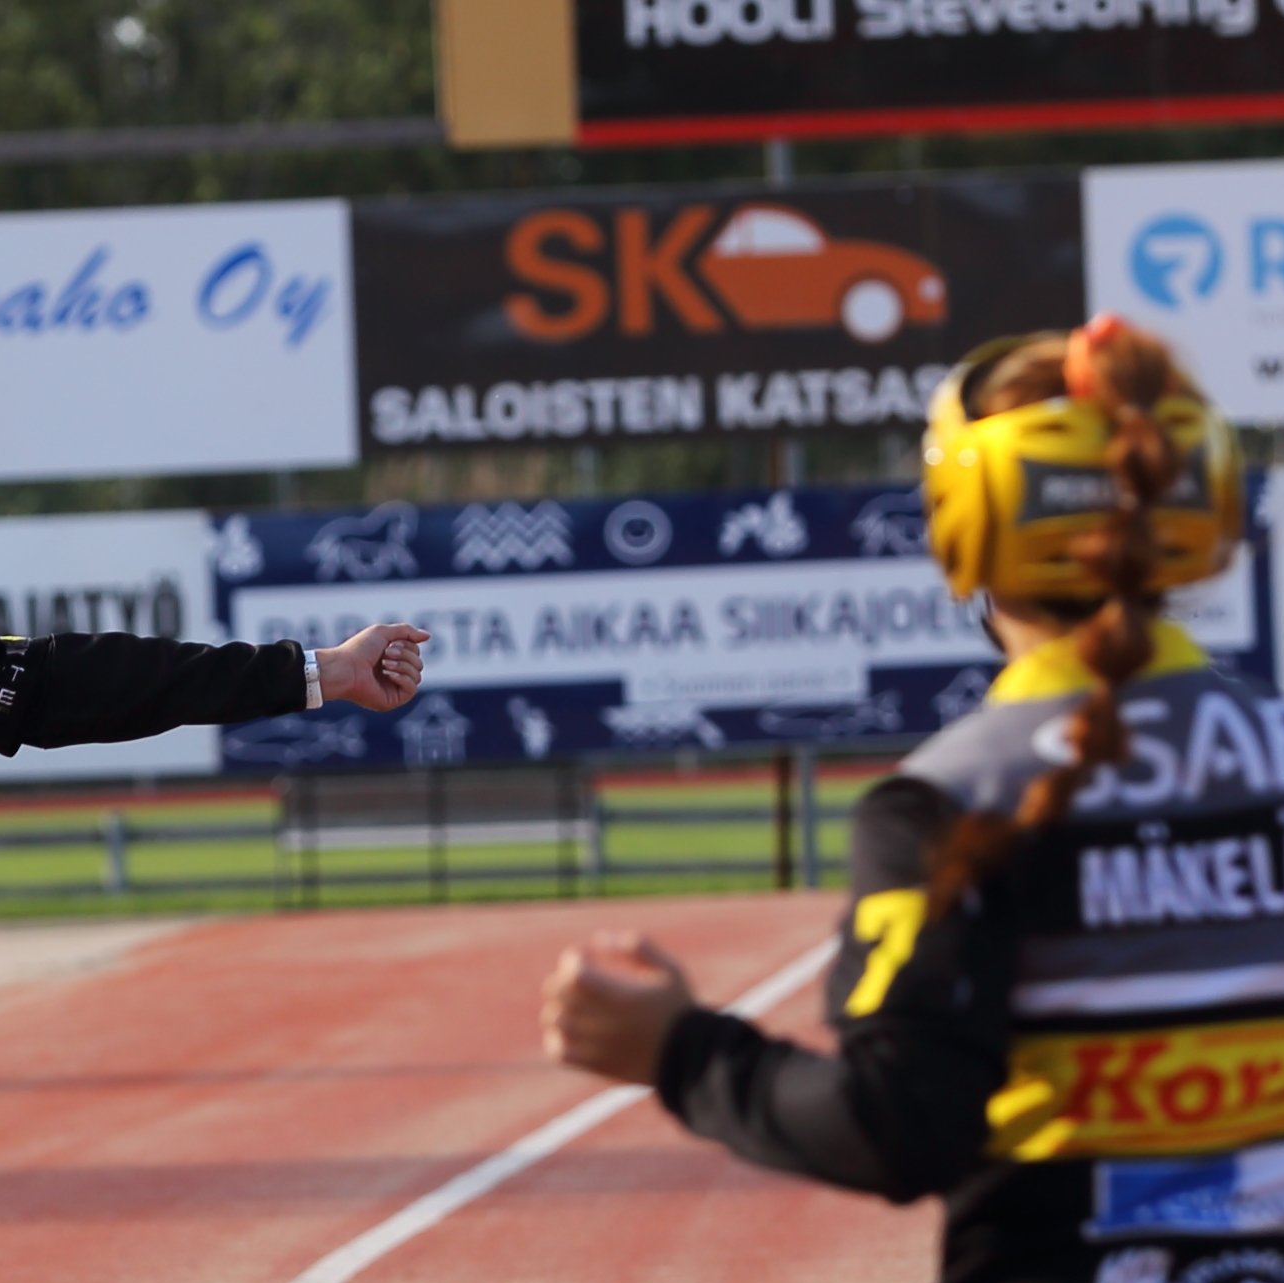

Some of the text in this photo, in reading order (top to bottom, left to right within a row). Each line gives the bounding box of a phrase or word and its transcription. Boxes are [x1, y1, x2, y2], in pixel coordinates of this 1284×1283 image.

[196, 240, 333, 349] Oy
[505, 206, 722, 341] SK
[371, 374, 704, 443] SALOISTEN
[531, 598, 705, 655] AIKAA
